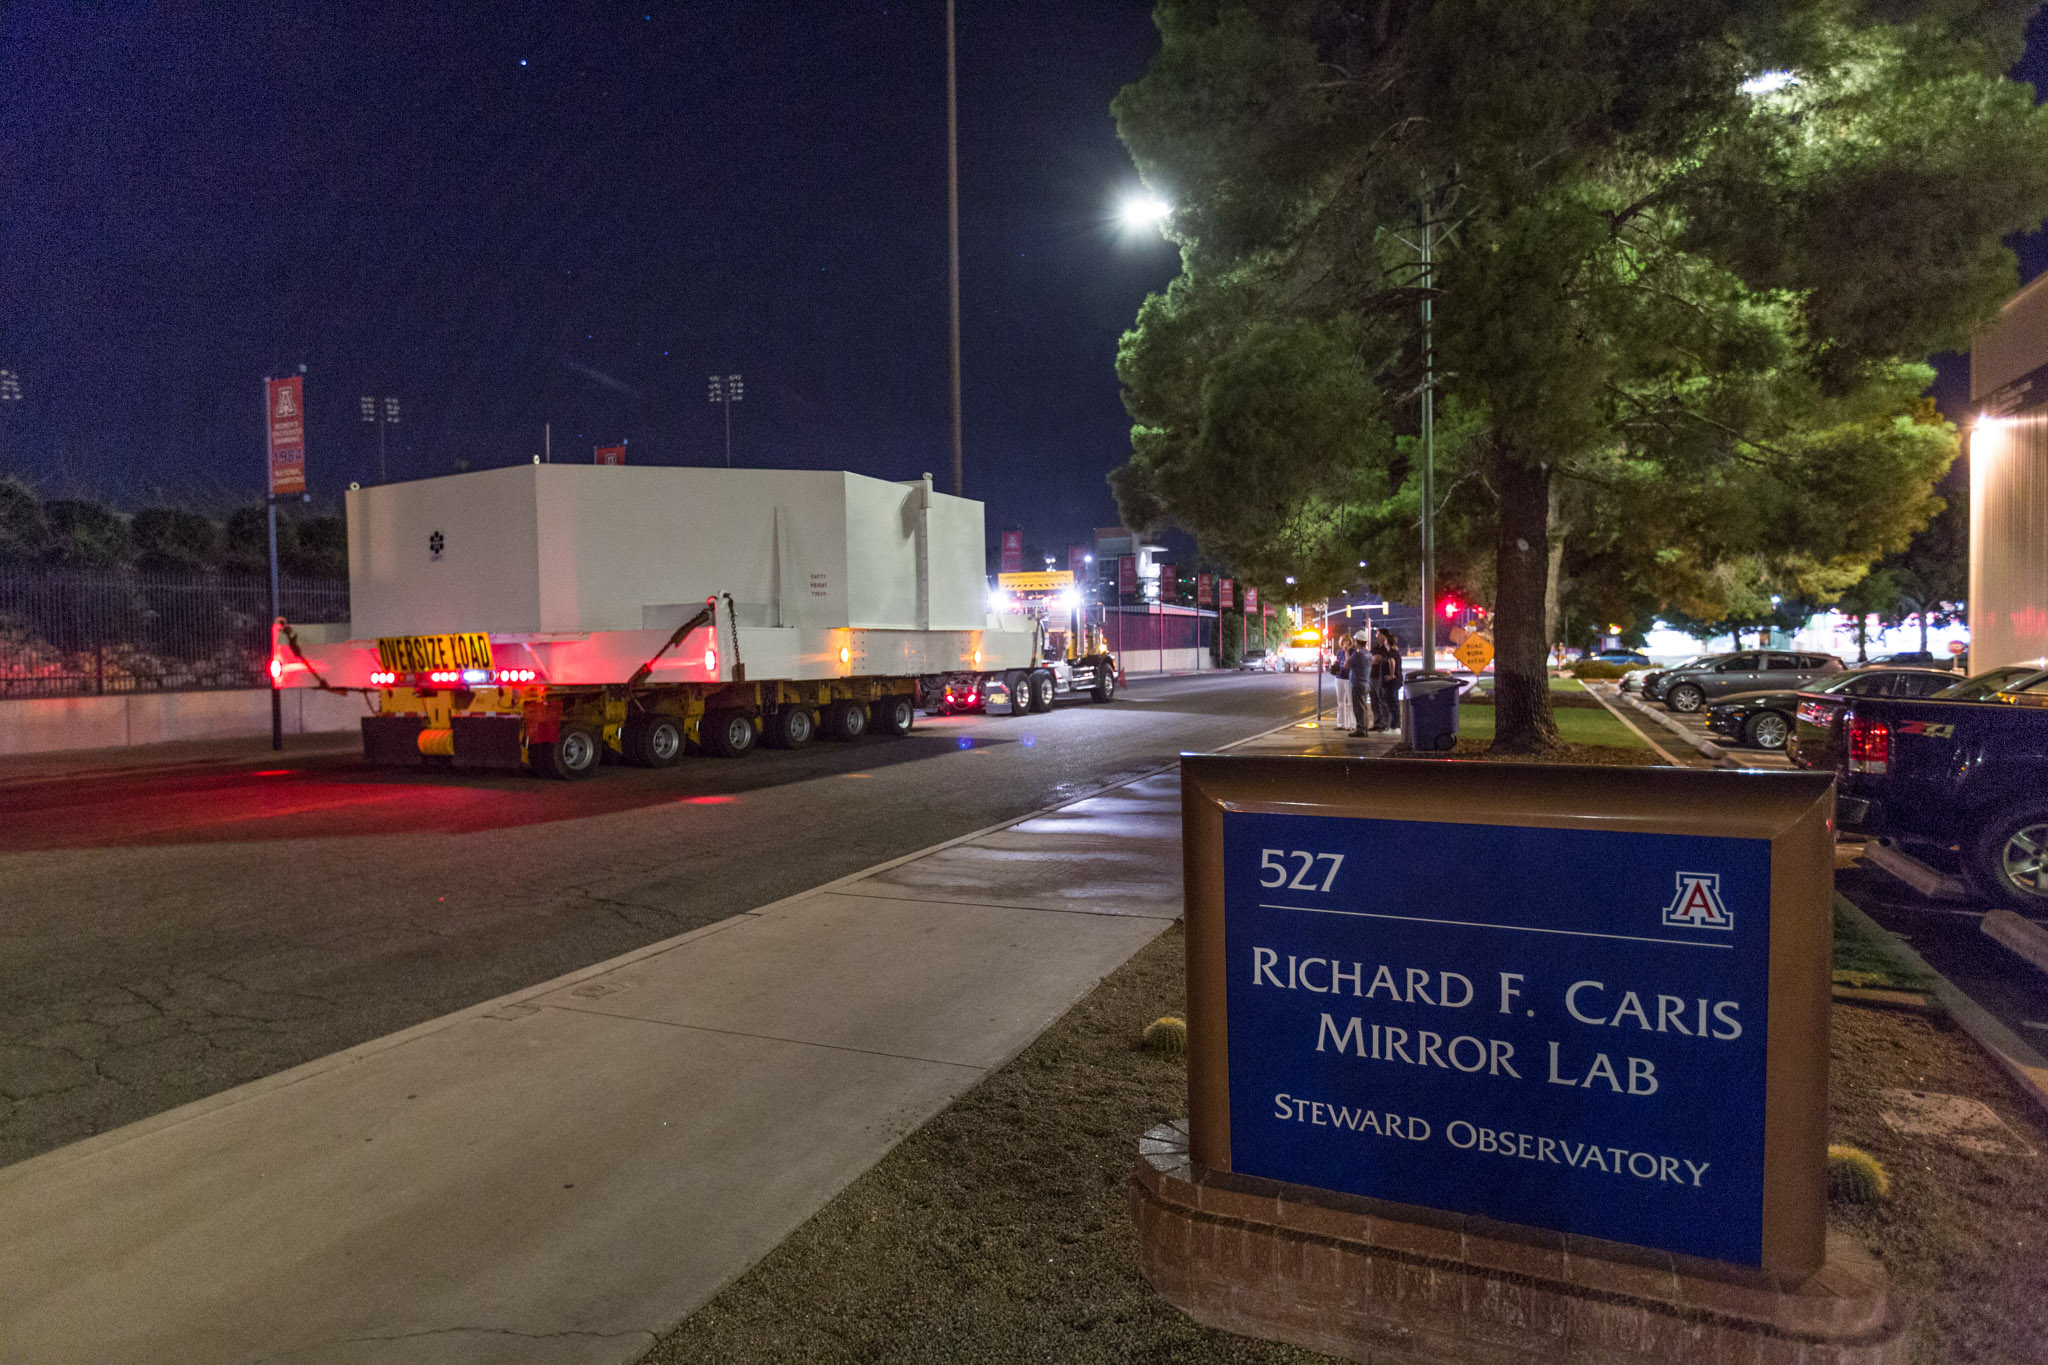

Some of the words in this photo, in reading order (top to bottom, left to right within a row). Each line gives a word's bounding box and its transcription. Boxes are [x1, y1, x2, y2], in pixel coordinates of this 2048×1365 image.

[379, 637, 448, 672] OVERSIZE
[451, 634, 491, 669] LOAD
[1260, 848, 1345, 892] 527
[1663, 871, 1734, 930] A
[1252, 946, 1474, 1008] RICHARD
[1499, 972, 1535, 1017] F.
[1565, 980, 1743, 1040] CARIS
[1315, 1012, 1522, 1078] MIRROR
[1548, 1041, 1659, 1096] LAB
[1274, 1093, 1431, 1141] STEWARD
[1446, 1120, 1710, 1187] OBSERVATORY
